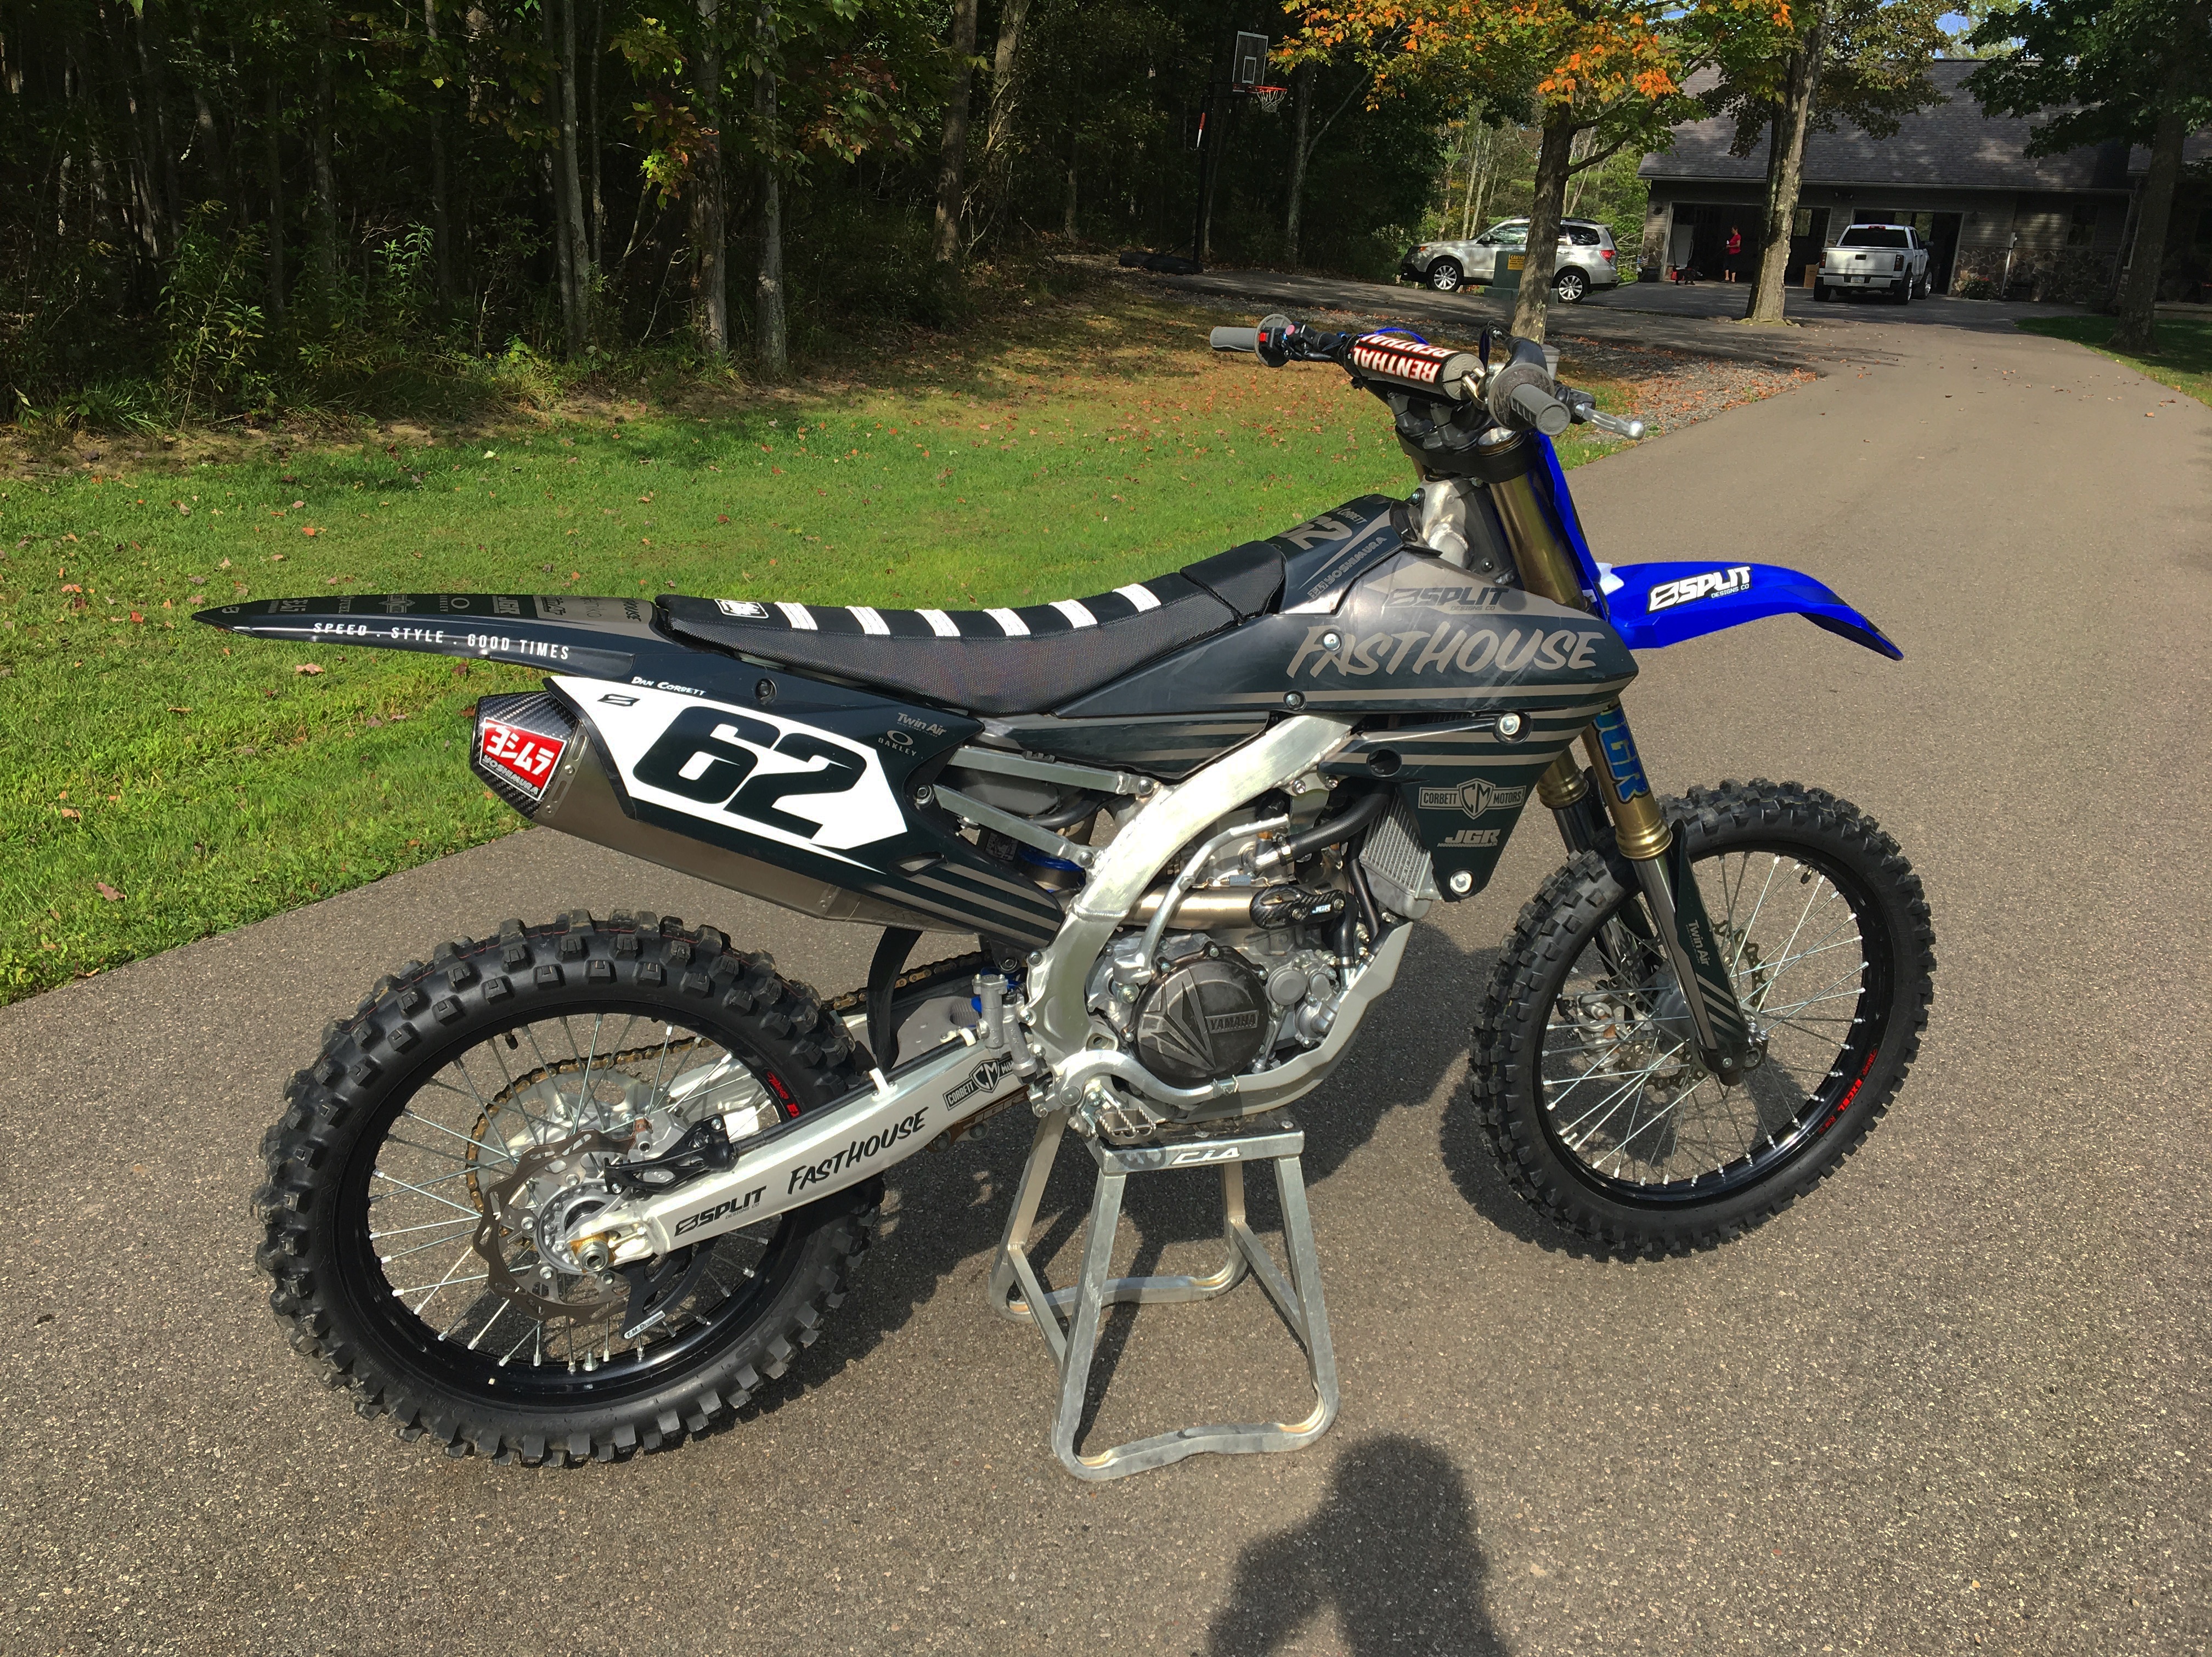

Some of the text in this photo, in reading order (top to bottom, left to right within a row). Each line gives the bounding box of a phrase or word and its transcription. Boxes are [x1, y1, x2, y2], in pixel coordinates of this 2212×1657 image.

[1353, 346, 1442, 383] RENTHAL
[1323, 537, 1387, 585] YOSHIMURA
[1414, 587, 1509, 607] SPLIT
[1678, 565, 1751, 602] SPLIT
[1711, 586, 1739, 598] DESIGNS
[498, 596, 521, 615] JGR
[313, 622, 569, 660] SPEED STYLE GOOD TIMES
[1286, 621, 1606, 680] FASTHOUSE
[631, 676, 707, 696] DAN CORBETT
[897, 712, 927, 729] Twin
[926, 723, 947, 736] Air
[485, 726, 555, 776] ヨシムラ
[878, 737, 917, 756] OAKLEY
[482, 754, 539, 795] YOSHIMURA
[633, 705, 867, 839] 62
[1423, 792, 1458, 805] CORBETT
[1493, 791, 1522, 805] MOTORS
[1444, 829, 1502, 843] JGR
[1688, 919, 1704, 949] Twin
[1697, 949, 1711, 966] Air
[1210, 1014, 1256, 1031] YAMAHA
[947, 1081, 974, 1105] CORBETT
[787, 1106, 929, 1195] FASTHOUSE
[697, 1185, 767, 1228] SPLIT
[725, 1207, 750, 1220] DESIGNS
